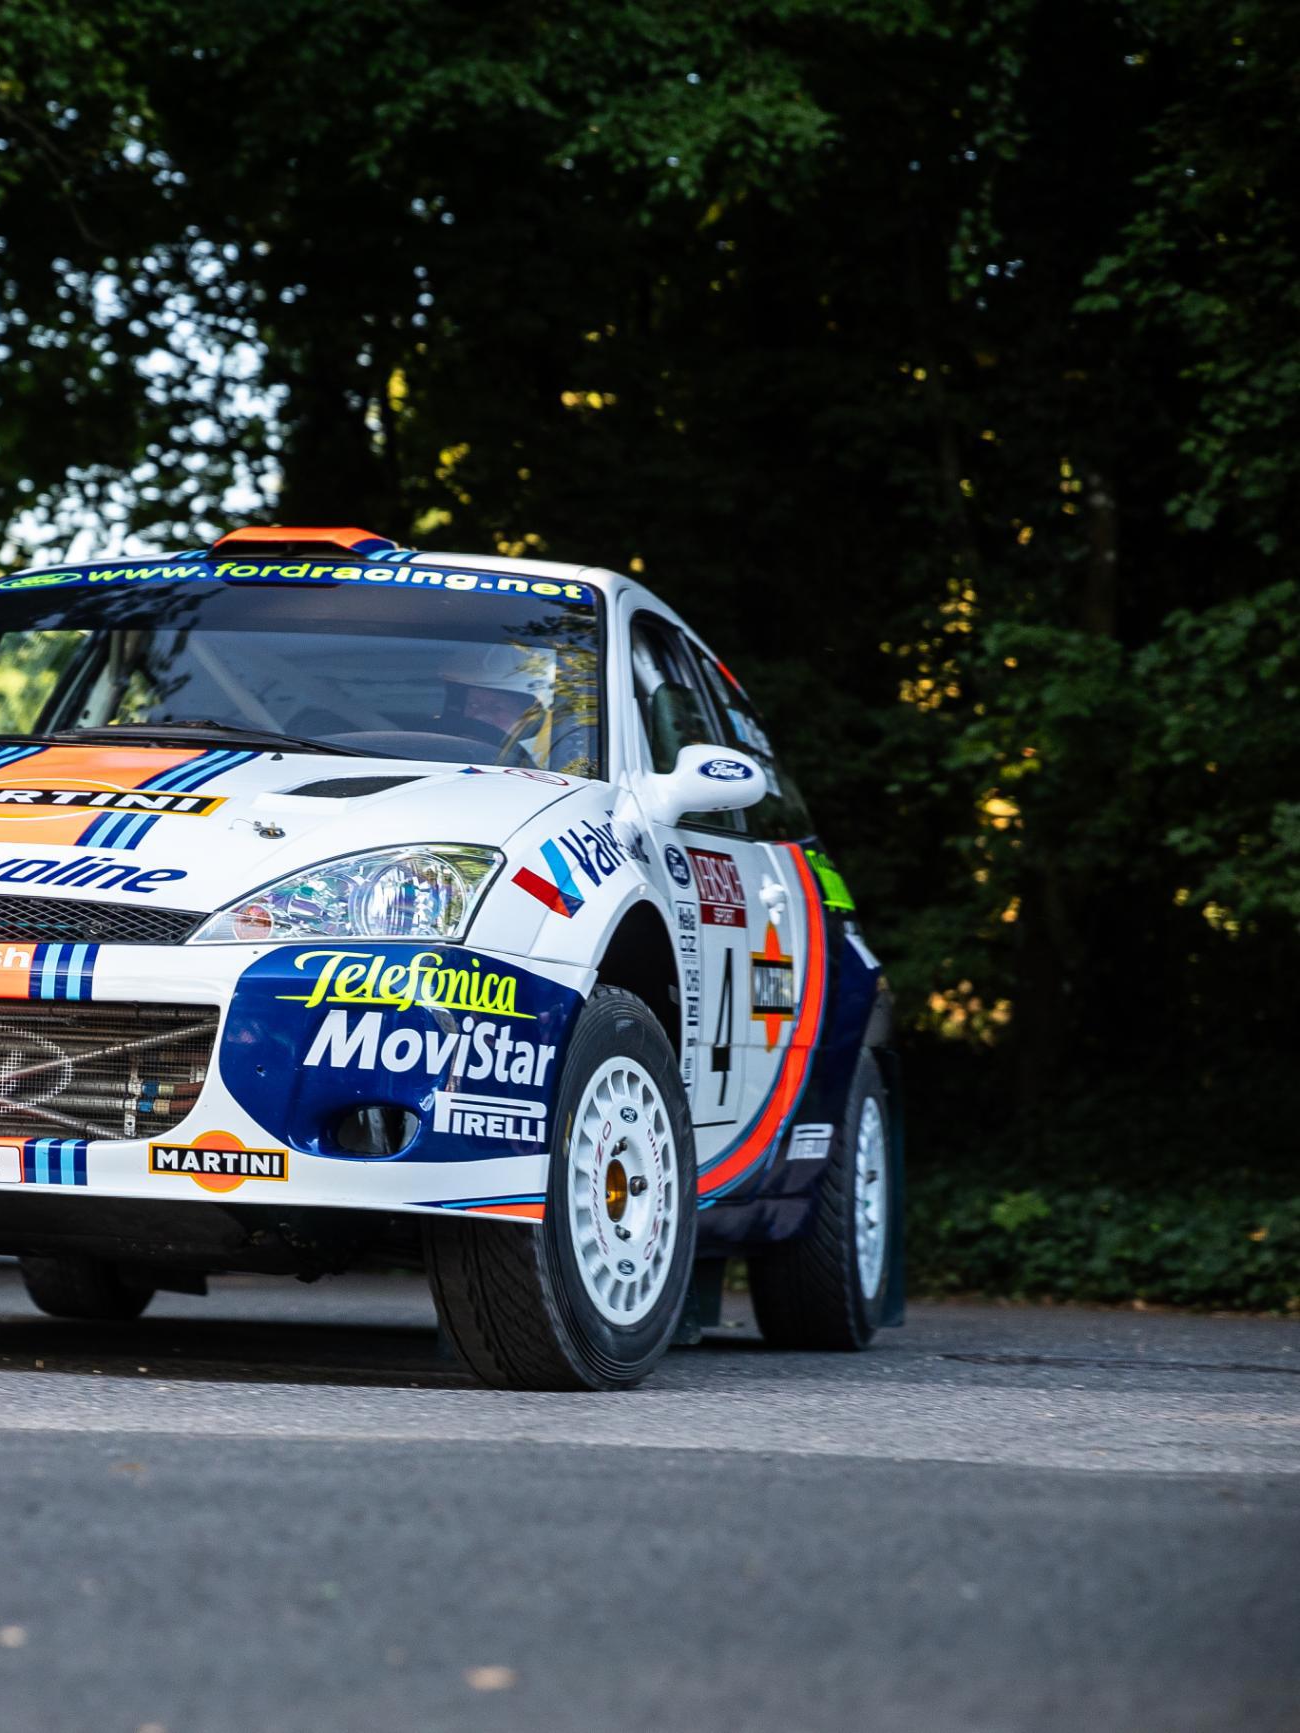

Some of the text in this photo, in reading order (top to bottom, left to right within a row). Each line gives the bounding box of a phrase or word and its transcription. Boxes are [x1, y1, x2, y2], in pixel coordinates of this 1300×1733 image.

[88, 562, 584, 600] www.fordracing.net
[709, 761, 745, 777] Ford
[303, 1009, 555, 1087] MoviStar
[711, 947, 734, 1107] 4
[432, 1091, 547, 1144] PIRELLI
[156, 1149, 280, 1177] MARTINI
